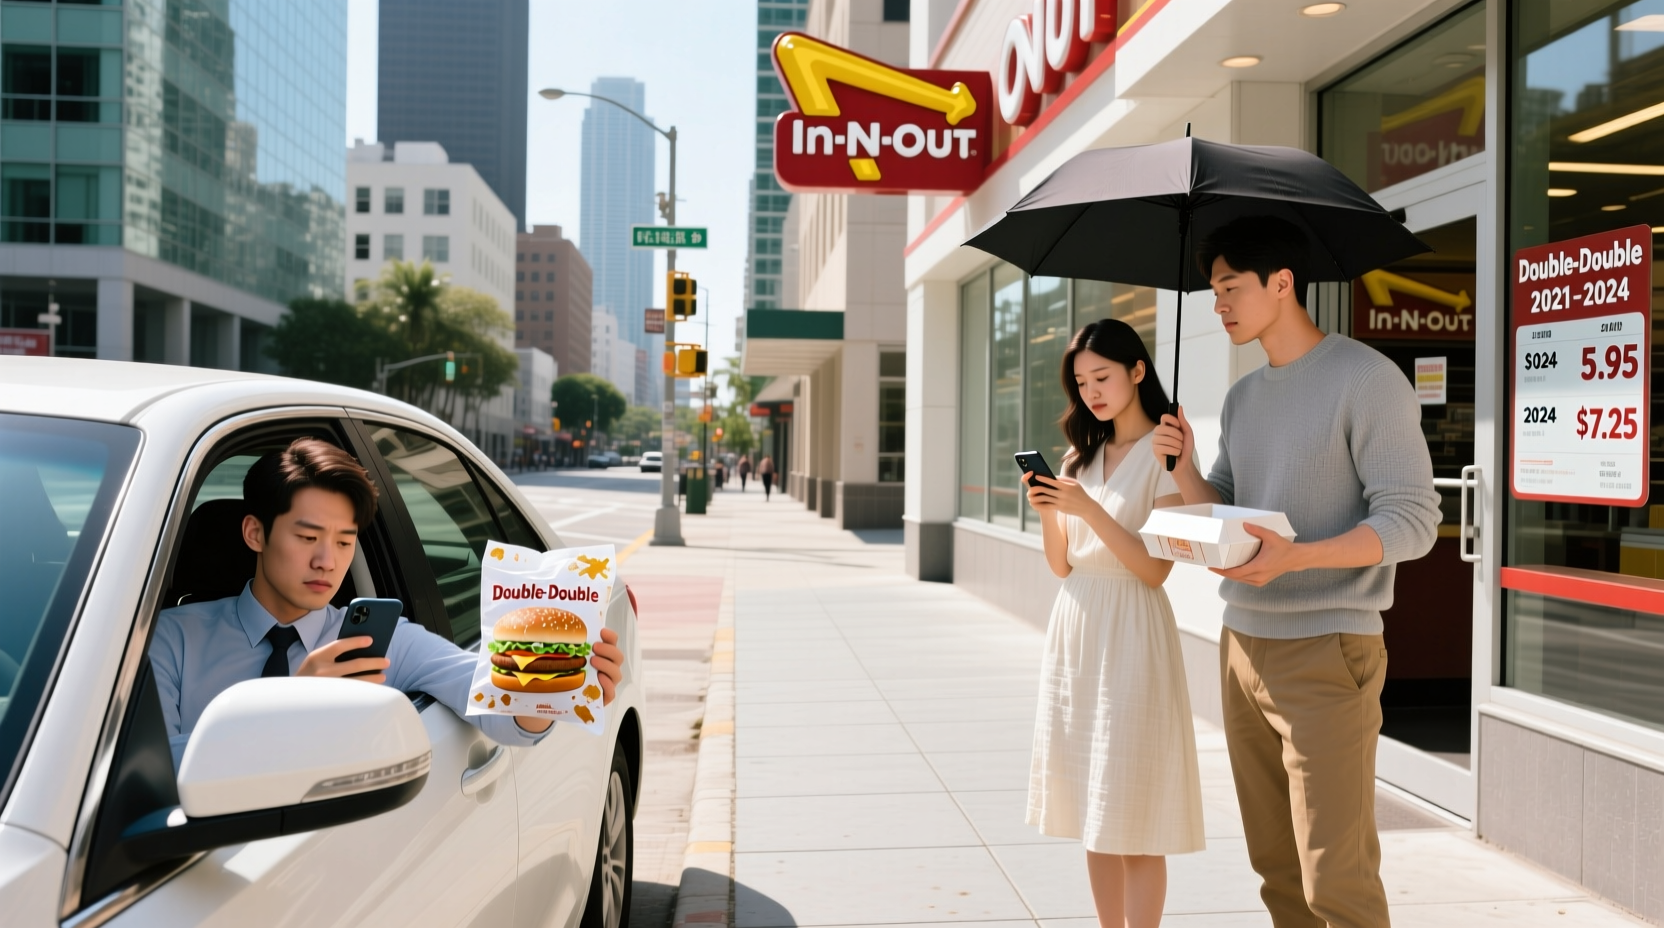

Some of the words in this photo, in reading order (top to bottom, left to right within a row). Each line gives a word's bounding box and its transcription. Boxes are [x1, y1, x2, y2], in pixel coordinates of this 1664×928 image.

[792, 119, 977, 159] In-N-OUT
[1518, 238, 1643, 283] Double-Double
[1369, 308, 1472, 332] In-N-OUT
[1580, 343, 1639, 381] 5.95
[1523, 406, 1557, 424] 2024
[1576, 405, 1638, 440] $7.25
[492, 583, 599, 602] Double-Double
